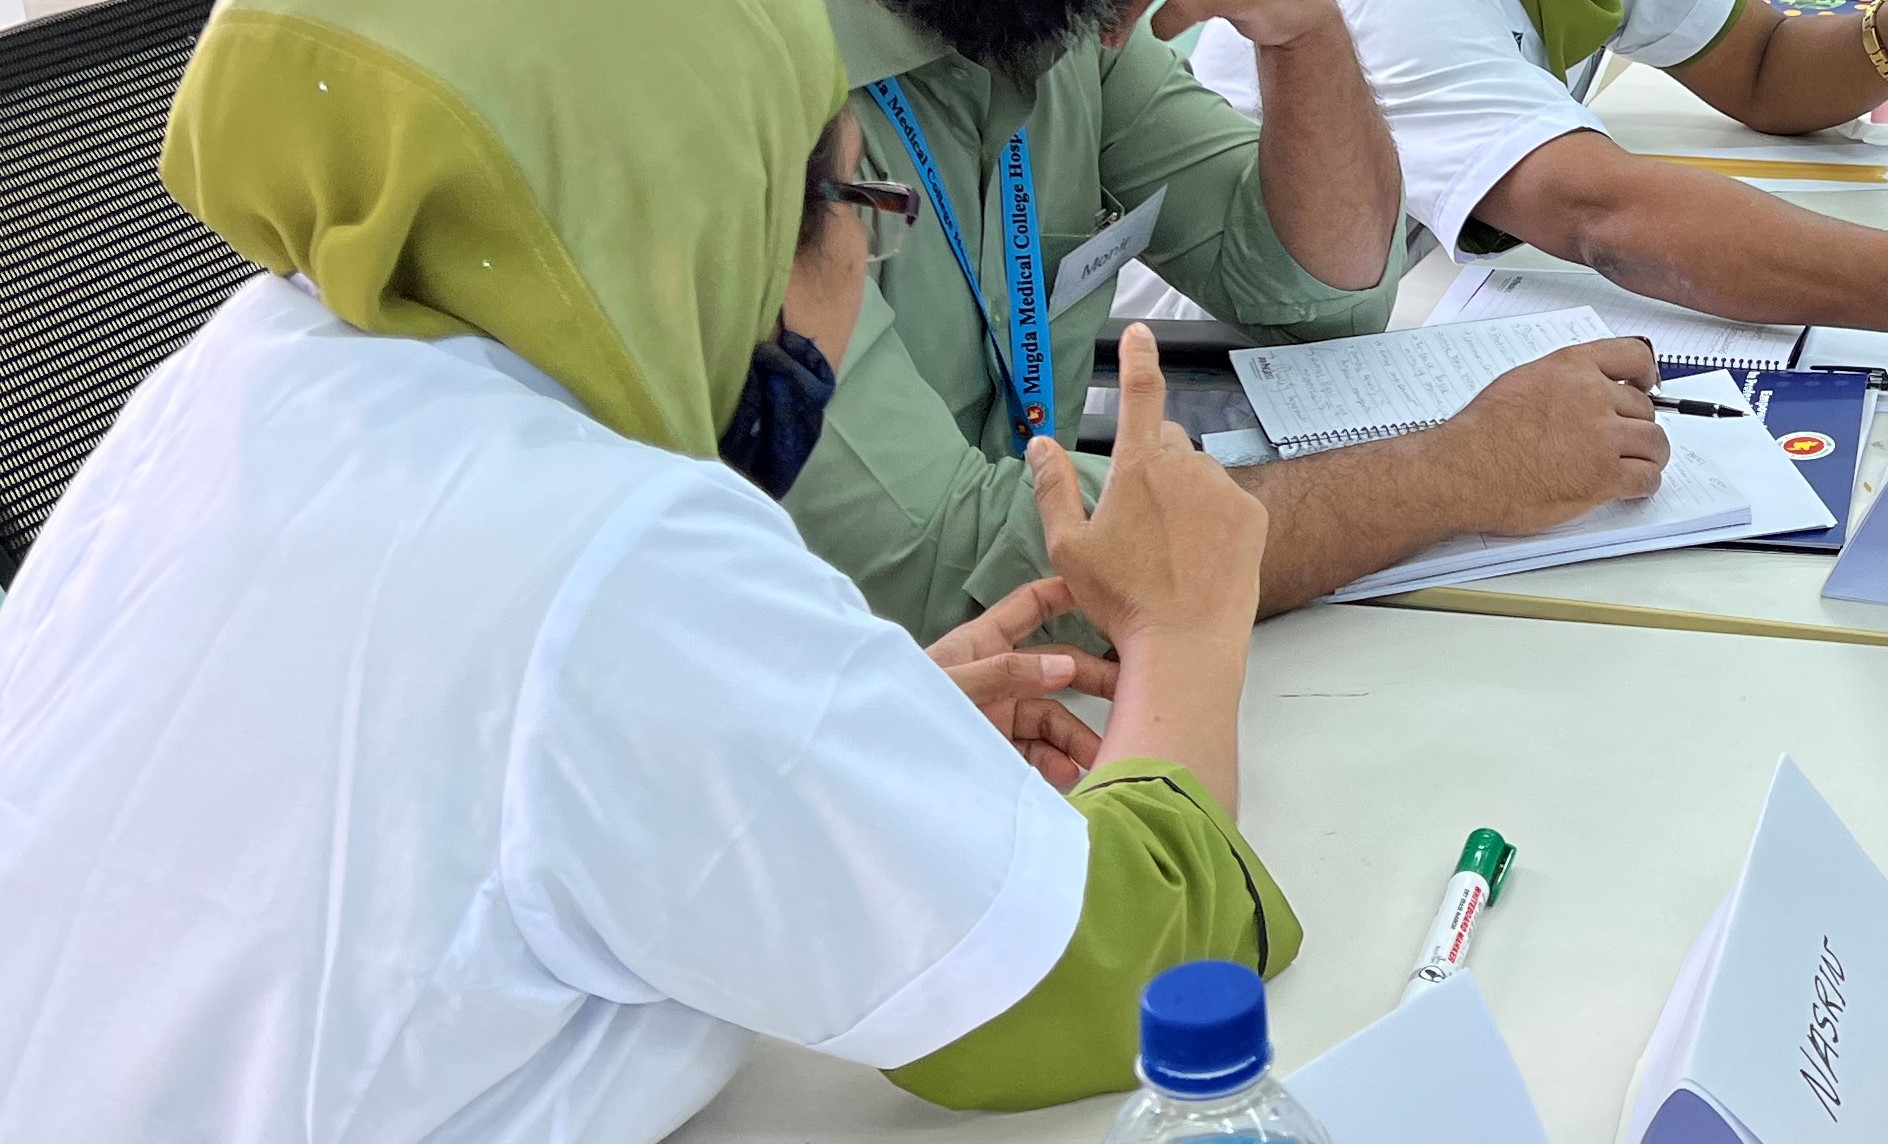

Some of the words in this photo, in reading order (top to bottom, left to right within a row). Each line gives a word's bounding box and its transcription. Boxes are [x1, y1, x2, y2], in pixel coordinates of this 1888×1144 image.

[1012, 183, 1030, 249] College
[1014, 253, 1037, 326] Medical
[1022, 330, 1045, 396] Mugda
[1799, 934, 1846, 1124] NASRIN
